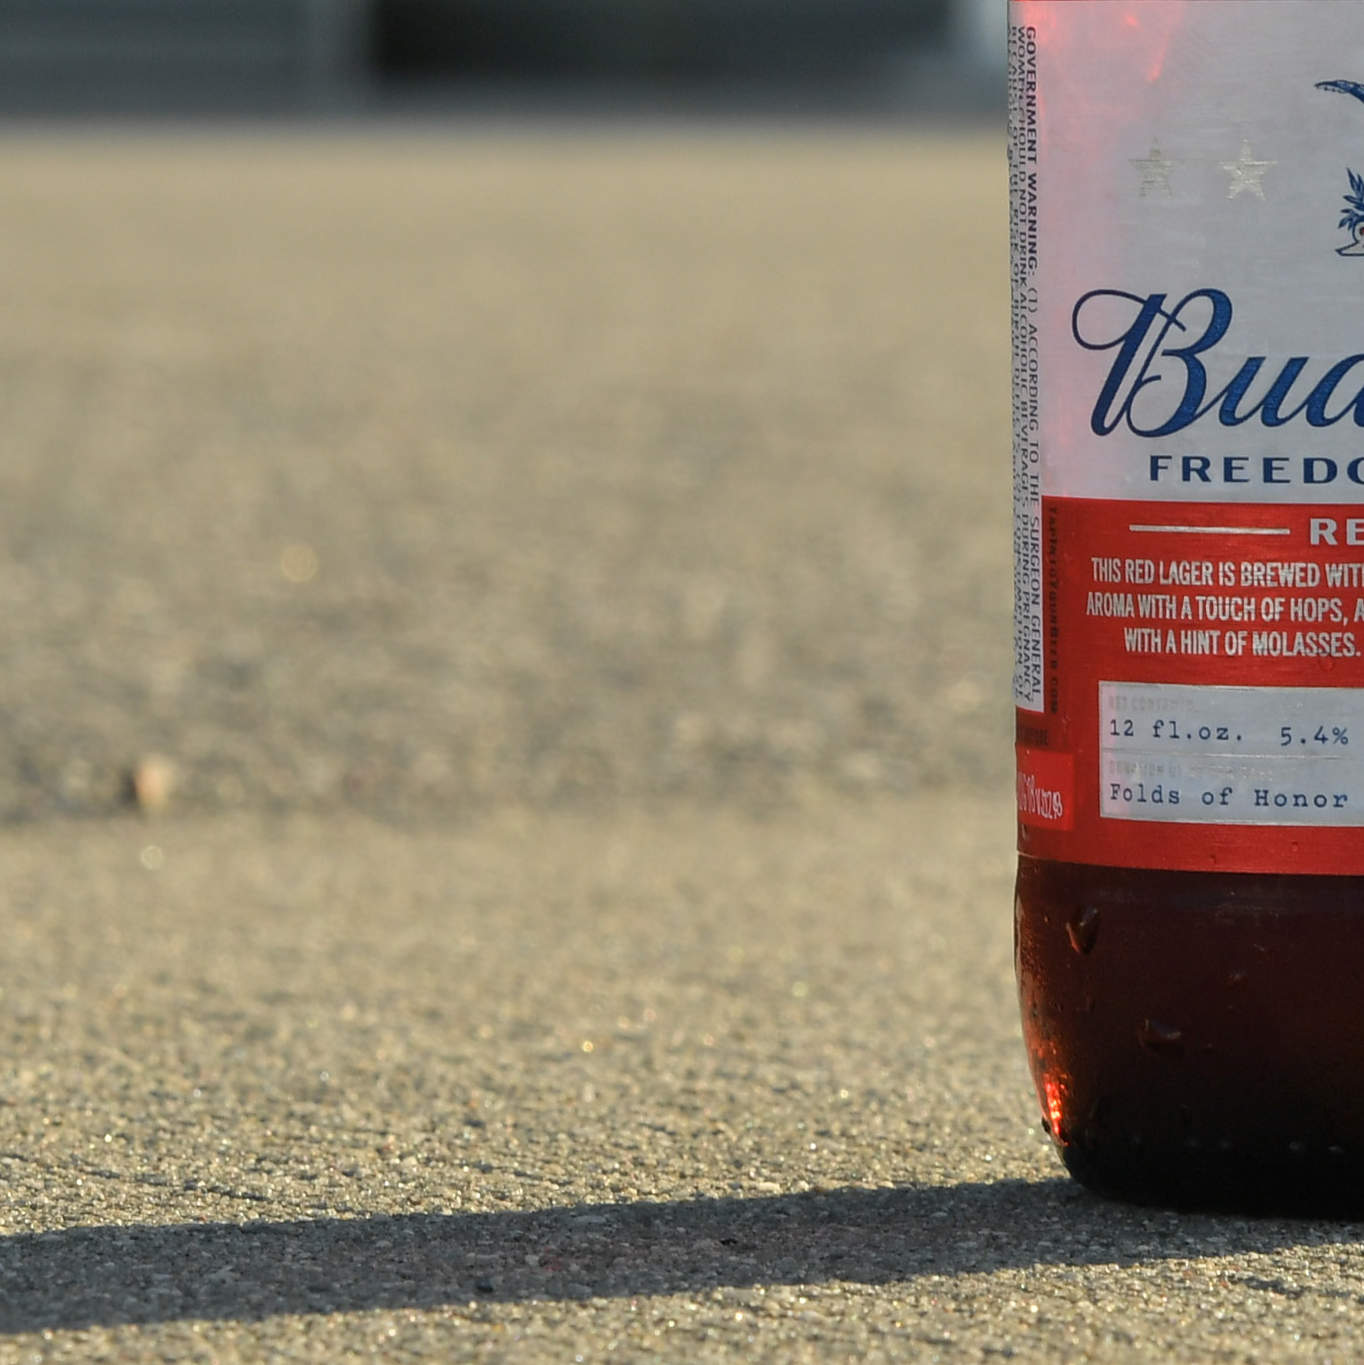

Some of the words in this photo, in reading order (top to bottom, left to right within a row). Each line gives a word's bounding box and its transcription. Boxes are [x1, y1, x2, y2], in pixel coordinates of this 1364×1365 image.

[1026, 26, 1037, 164] GOVERNMENT
[1027, 172, 1038, 276] WARNING:
[1019, 231, 1027, 287] DRINK
[1027, 286, 1038, 314] (1)
[1028, 323, 1038, 432] ACCORDING
[1029, 440, 1039, 464] TO
[1030, 474, 1040, 506] THE
[1022, 514, 1030, 585] DURING
[1030, 516, 1040, 605] SURGEON
[1091, 557, 1122, 584] THIS
[1125, 559, 1155, 585] RED
[1158, 561, 1213, 586] LAGER
[1218, 562, 1236, 586] IS
[1240, 562, 1321, 588] BREWED
[1087, 592, 1135, 618] AROMA
[1138, 594, 1177, 620] WITH
[1181, 596, 1193, 620] A
[1195, 596, 1256, 622] TOUCH
[1260, 597, 1285, 621] OF
[1289, 598, 1349, 626] HOPS,
[1124, 627, 1162, 653] WITH
[1165, 629, 1176, 653] A
[1180, 630, 1221, 655] HINT
[1224, 631, 1247, 655] OF
[1252, 631, 1361, 657] MOLASSES.
[1109, 719, 1134, 737] 12
[1151, 719, 1243, 741] fl.oz.
[1280, 725, 1349, 746] 5.4%
[1109, 783, 1180, 804] Folds
[1201, 787, 1233, 806] of
[1254, 789, 1348, 808] Honor
